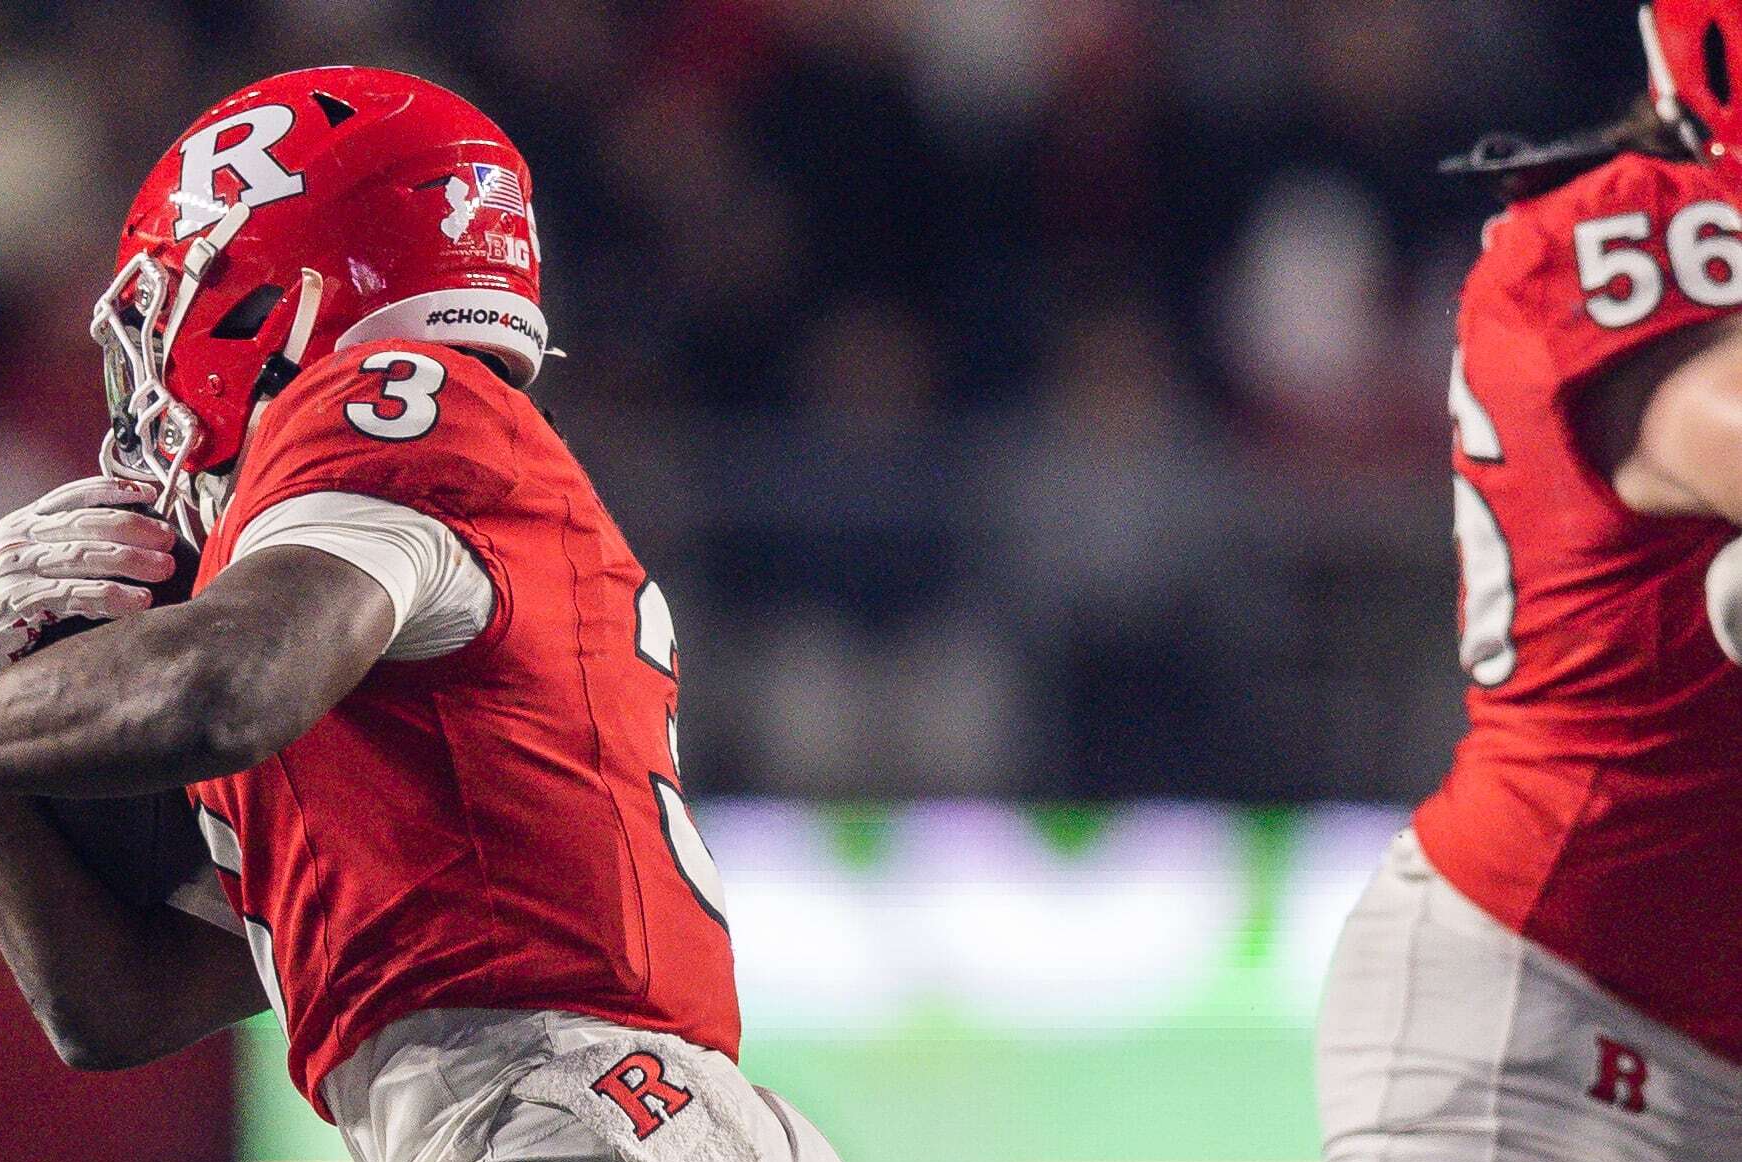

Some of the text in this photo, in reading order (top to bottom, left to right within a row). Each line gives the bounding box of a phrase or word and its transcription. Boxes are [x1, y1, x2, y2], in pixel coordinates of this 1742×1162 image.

[173, 103, 307, 242] R
[1573, 201, 1742, 328] 56
[343, 351, 448, 442] 3
[589, 1051, 694, 1141] R
[1587, 1033, 1646, 1114] R
